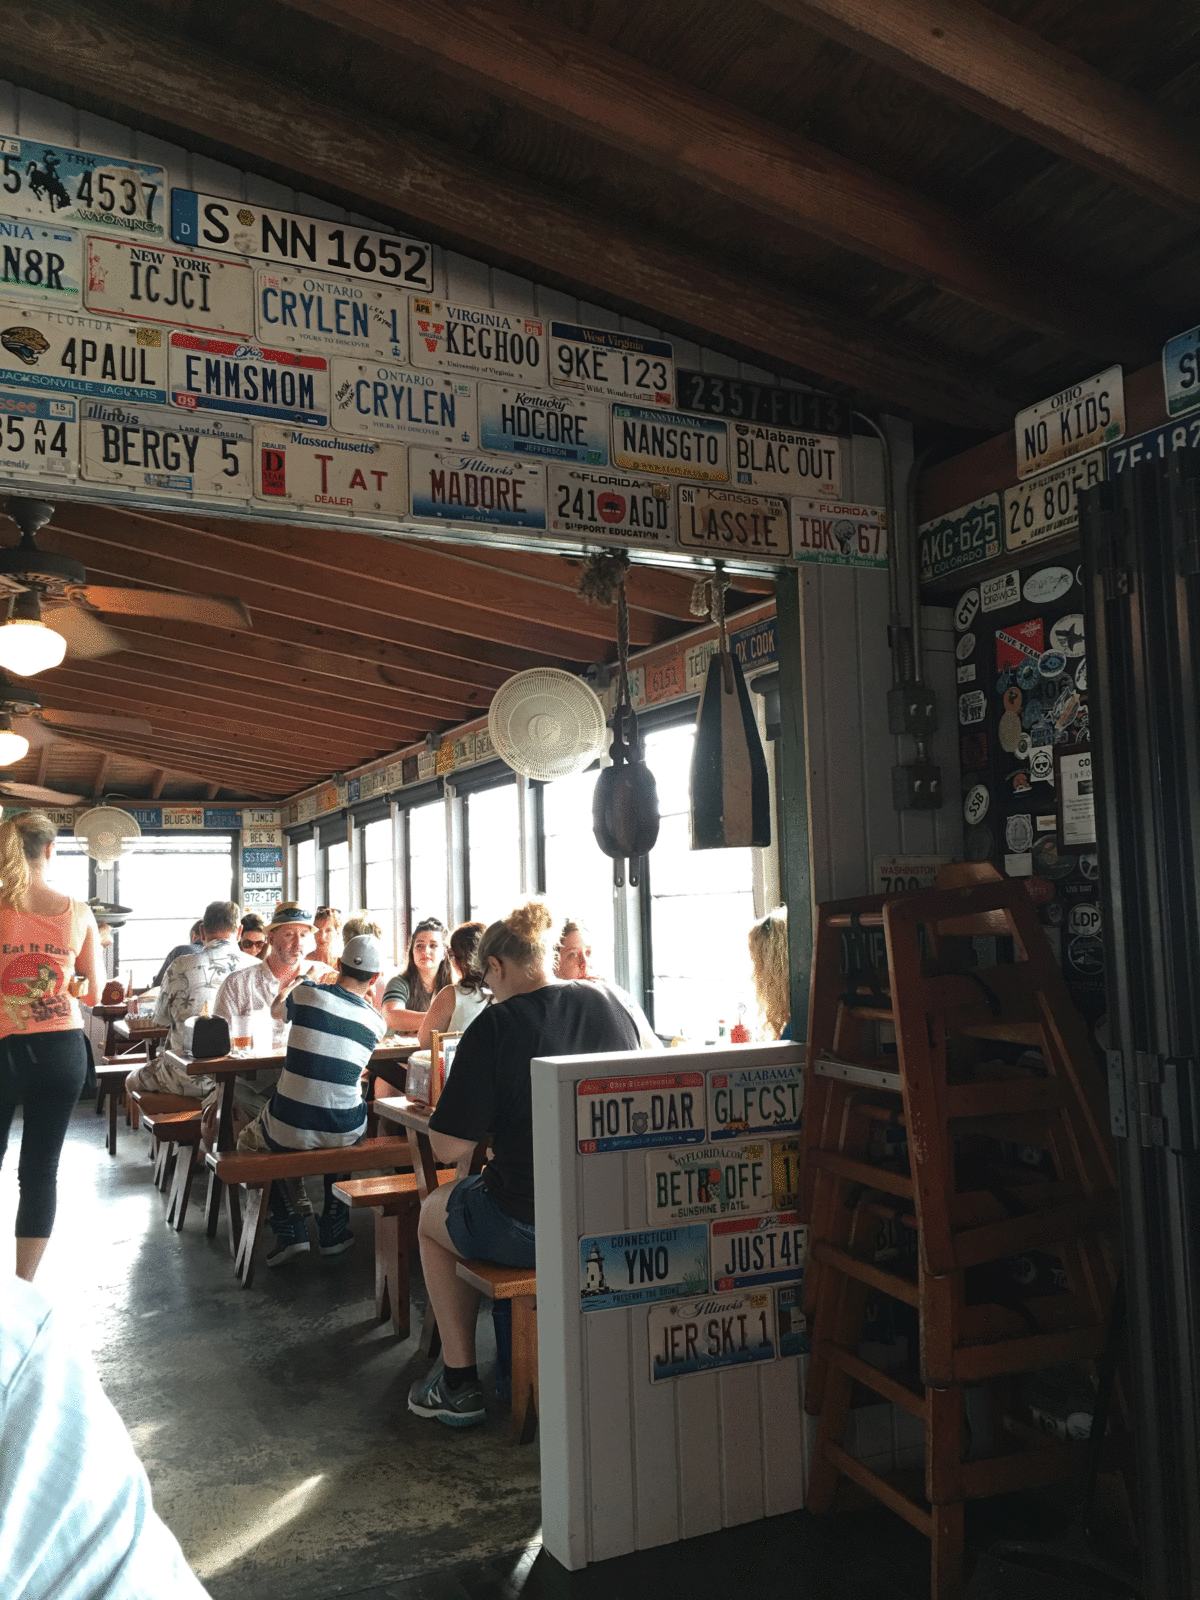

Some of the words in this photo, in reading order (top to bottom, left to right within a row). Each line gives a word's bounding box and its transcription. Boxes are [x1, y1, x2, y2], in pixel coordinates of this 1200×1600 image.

[65, 152, 96, 168] TRK
[77, 170, 158, 223] 4537
[77, 208, 158, 233] WYOMING
[180, 222, 190, 235] D
[202, 203, 230, 244] S
[262, 214, 316, 262] NN
[327, 229, 427, 285] 1652
[130, 248, 164, 264] NEW
[172, 256, 212, 274] YORK
[130, 261, 210, 312] ICJCI
[303, 279, 363, 299] ONTARIO
[48, 313, 112, 331] FLORIDA
[263, 288, 369, 337] CRYLEN
[390, 309, 400, 343] 1
[447, 307, 511, 330] VIRGINIA
[299, 333, 322, 342] YOURS
[324, 336, 334, 344] TO
[336, 338, 370, 349] DISCOVER
[582, 329, 605, 344] West
[607, 334, 644, 351] Virginia
[61, 337, 156, 386] 4PAUL
[234, 345, 264, 359] Ohio
[377, 368, 434, 387] ONTARIO
[447, 361, 480, 373] University
[489, 368, 515, 378] Virginia
[558, 344, 608, 382] 9KE
[622, 355, 667, 391] 123
[100, 384, 157, 400] JAGUARS
[186, 354, 314, 409] EMMSMOM
[586, 384, 604, 394] Wild,
[607, 388, 642, 400] Wonderful
[55, 403, 66, 411] 15
[356, 380, 455, 428] CRYLEN
[515, 392, 566, 412] Kentucky
[1051, 386, 1082, 409] OHIO
[373, 421, 395, 430] YOURS
[408, 425, 440, 436] DISCOVER
[640, 410, 700, 428] PENNSYLVANIA
[1025, 421, 1048, 461] NO
[1061, 391, 1110, 446] KIDS
[179, 425, 199, 434] Land
[212, 428, 244, 439] Lincoln
[755, 428, 816, 448] Alabama
[101, 423, 199, 473] BERGY
[222, 439, 239, 477] 5
[262, 442, 287, 450] DEALER
[290, 432, 375, 454] Massachusetts
[525, 444, 567, 456] JEFFERSON
[623, 421, 718, 465] NANSGTO
[265, 451, 284, 472] D
[446, 456, 514, 477] Illinois
[737, 438, 789, 474] BLAC
[798, 447, 835, 480] OUT
[314, 453, 333, 494] T
[350, 469, 389, 491] AT
[581, 473, 641, 489] FLORIDA
[1039, 470, 1065, 488] ILLINOIS
[315, 494, 353, 506] DEALER
[430, 469, 526, 513] MADORE
[682, 489, 693, 503] SN
[707, 489, 759, 505] Kansas
[558, 485, 598, 522] 241
[819, 504, 869, 517] FLORIDA
[1010, 496, 1034, 534] 26
[609, 527, 659, 539] EDUCATION
[691, 506, 778, 547] LASSIE
[800, 517, 835, 551] IBK
[858, 523, 888, 555] 67
[934, 548, 983, 574] COLORADO
[958, 597, 978, 625] CTL
[751, 629, 775, 659] COOK
[998, 632, 1018, 647] DIVE
[1019, 643, 1041, 659] TEAM
[880, 866, 936, 876] WASHINGTON
[1073, 912, 1099, 927] LDP
[3, 944, 24, 954] Eat
[740, 1068, 795, 1082] ALABAMA
[715, 1083, 799, 1124] GLFCST
[591, 1097, 634, 1138] HOT
[652, 1093, 694, 1131] DAR
[674, 1148, 744, 1167] MYFLORIDA.COM
[725, 1162, 763, 1199] OFF
[677, 1204, 717, 1218] SUNSHINE
[720, 1200, 746, 1213] STATE
[759, 1216, 780, 1229] Ohio
[611, 1230, 679, 1248] CONNECTICUT
[725, 1229, 804, 1275] JUST4F
[624, 1245, 669, 1284] YNO
[612, 1290, 644, 1303] PRESERVE
[646, 1289, 657, 1298] THE
[660, 1287, 679, 1296] SOUND
[680, 1300, 744, 1320] Illinois
[655, 1323, 700, 1366] JER
[708, 1314, 748, 1357] SKI
[759, 1310, 772, 1347] 1
